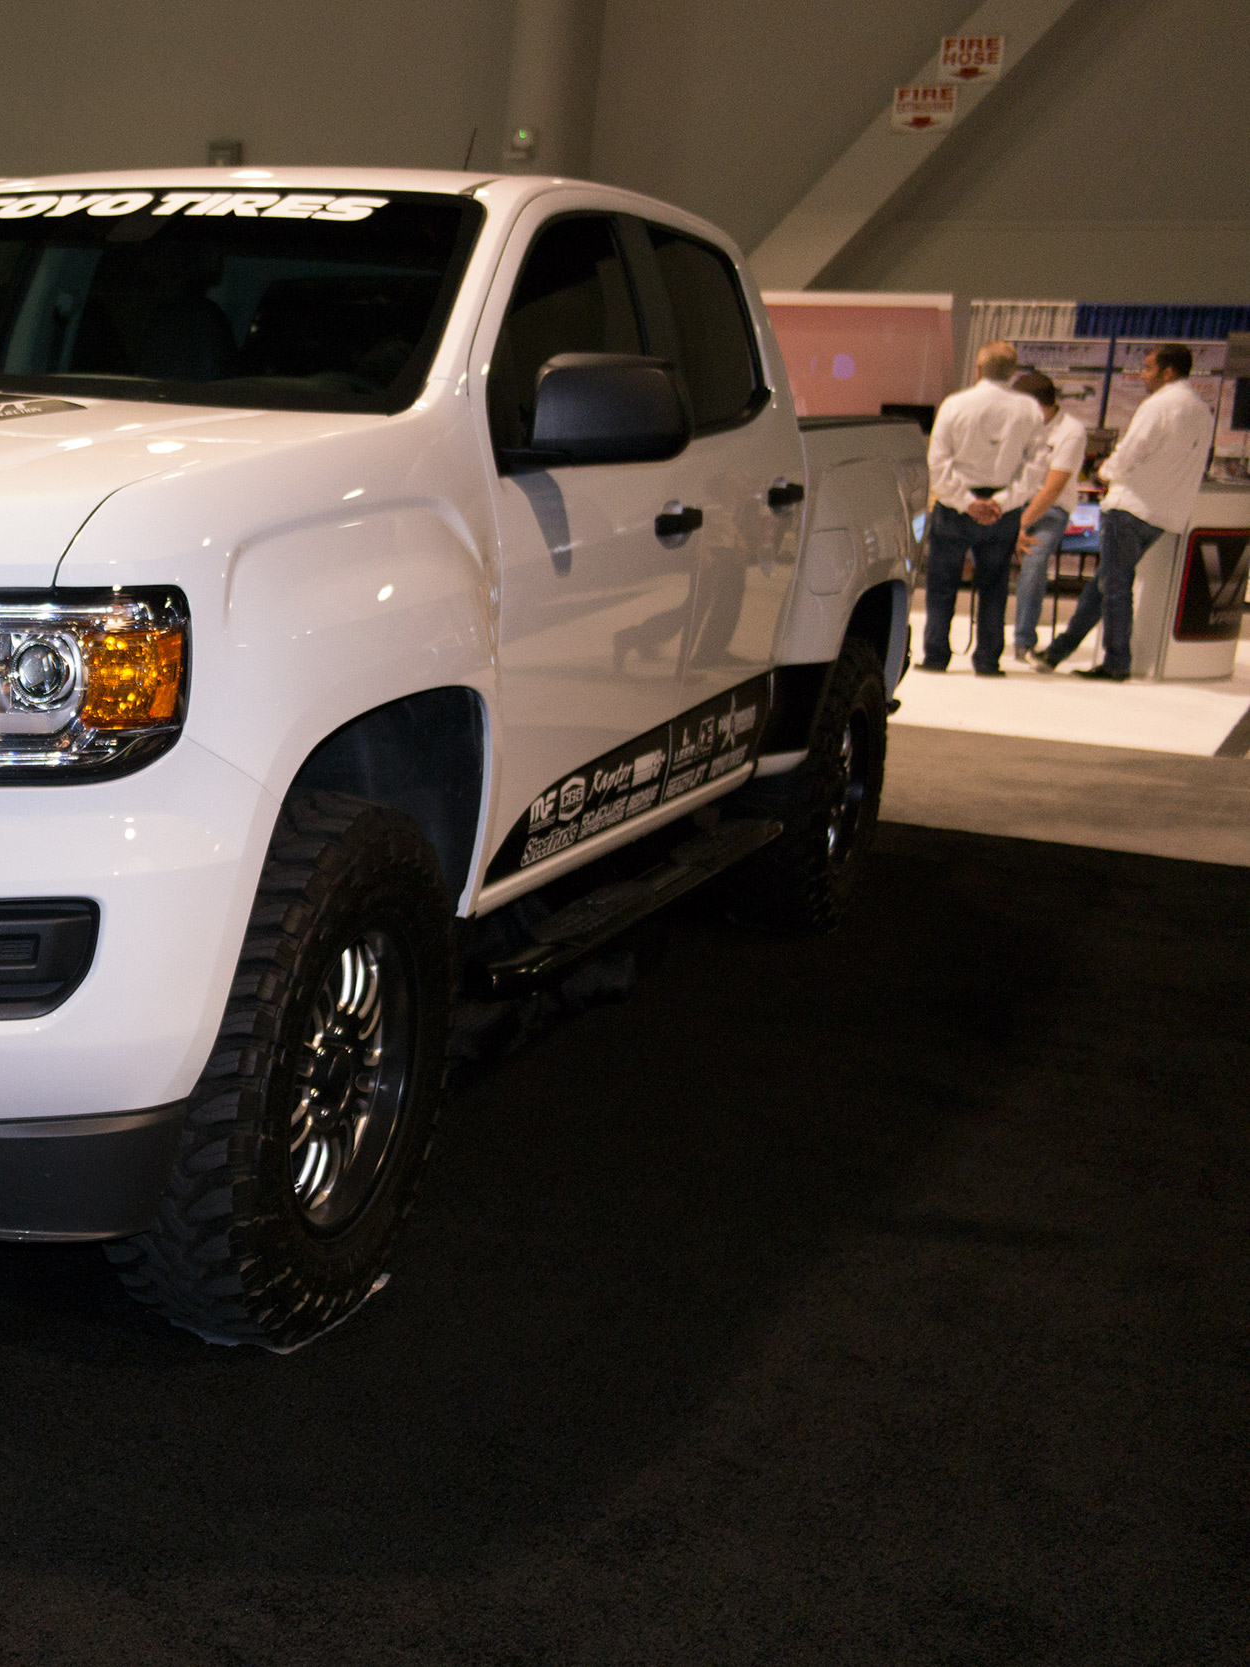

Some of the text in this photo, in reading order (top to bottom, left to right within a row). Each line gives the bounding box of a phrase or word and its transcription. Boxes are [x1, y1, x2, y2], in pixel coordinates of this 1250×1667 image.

[944, 36, 1000, 50] FIRE
[942, 52, 999, 65] HOSE
[898, 87, 955, 101] FIRE
[151, 193, 390, 221] TIRES
[586, 762, 635, 805] Raptor
